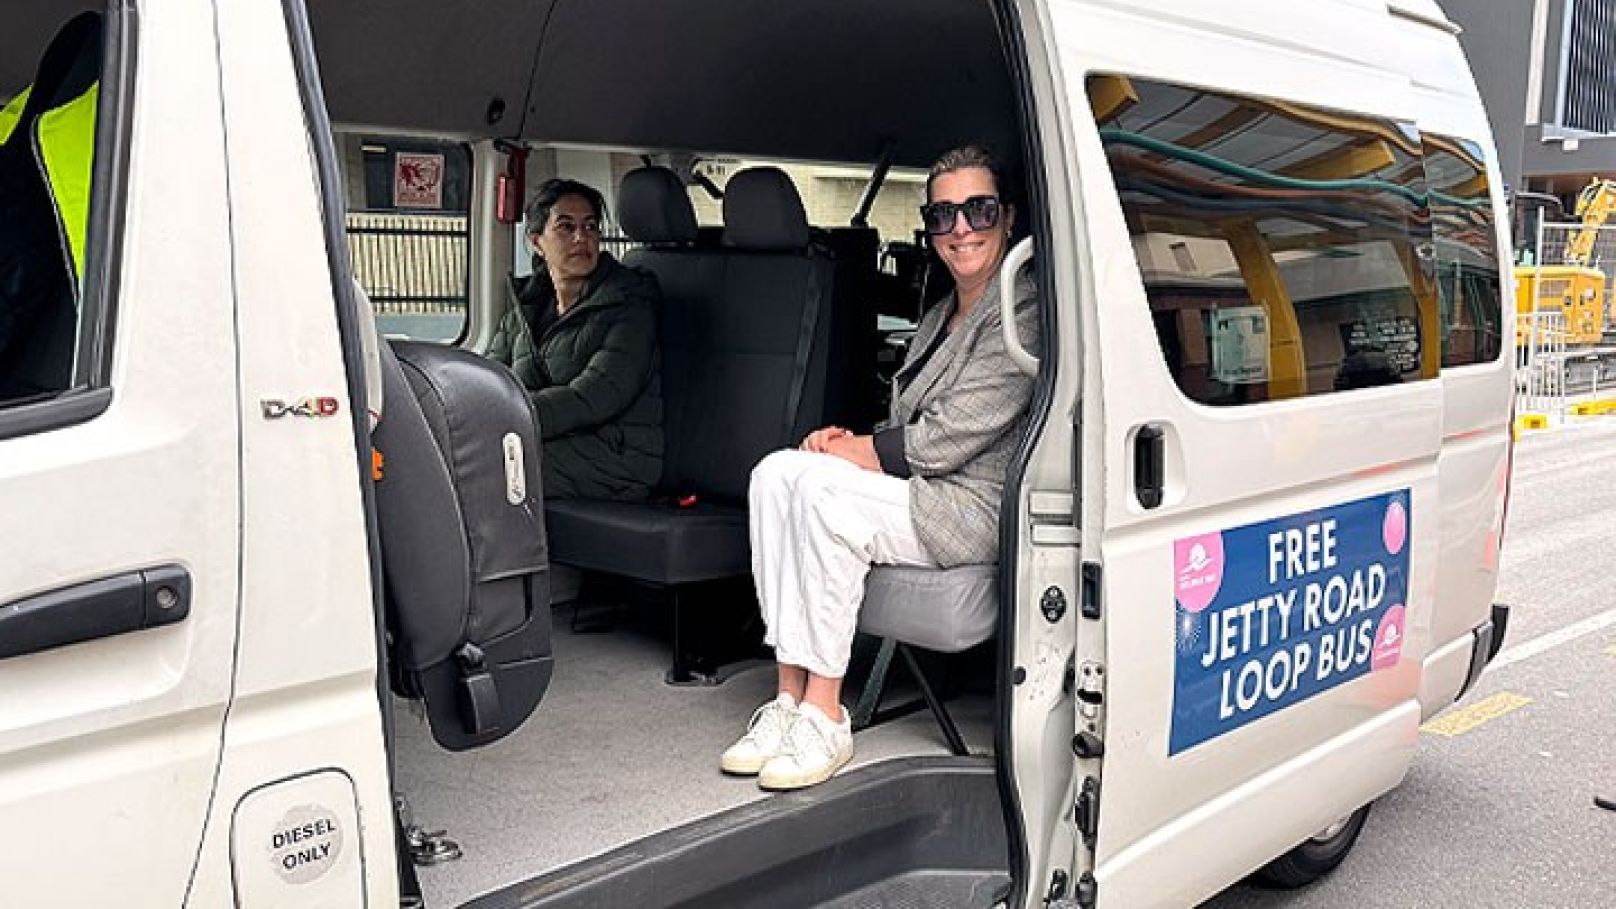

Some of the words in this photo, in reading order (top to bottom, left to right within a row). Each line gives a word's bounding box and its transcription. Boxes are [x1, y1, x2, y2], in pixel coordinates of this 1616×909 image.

[1268, 519, 1338, 584] FREE
[1200, 588, 1298, 668] JETTY
[1303, 563, 1386, 632] ROAD
[1219, 641, 1312, 720] LOOP
[1316, 619, 1372, 681] BUS
[272, 818, 336, 849] DIESEL
[282, 841, 331, 869] ONLY
